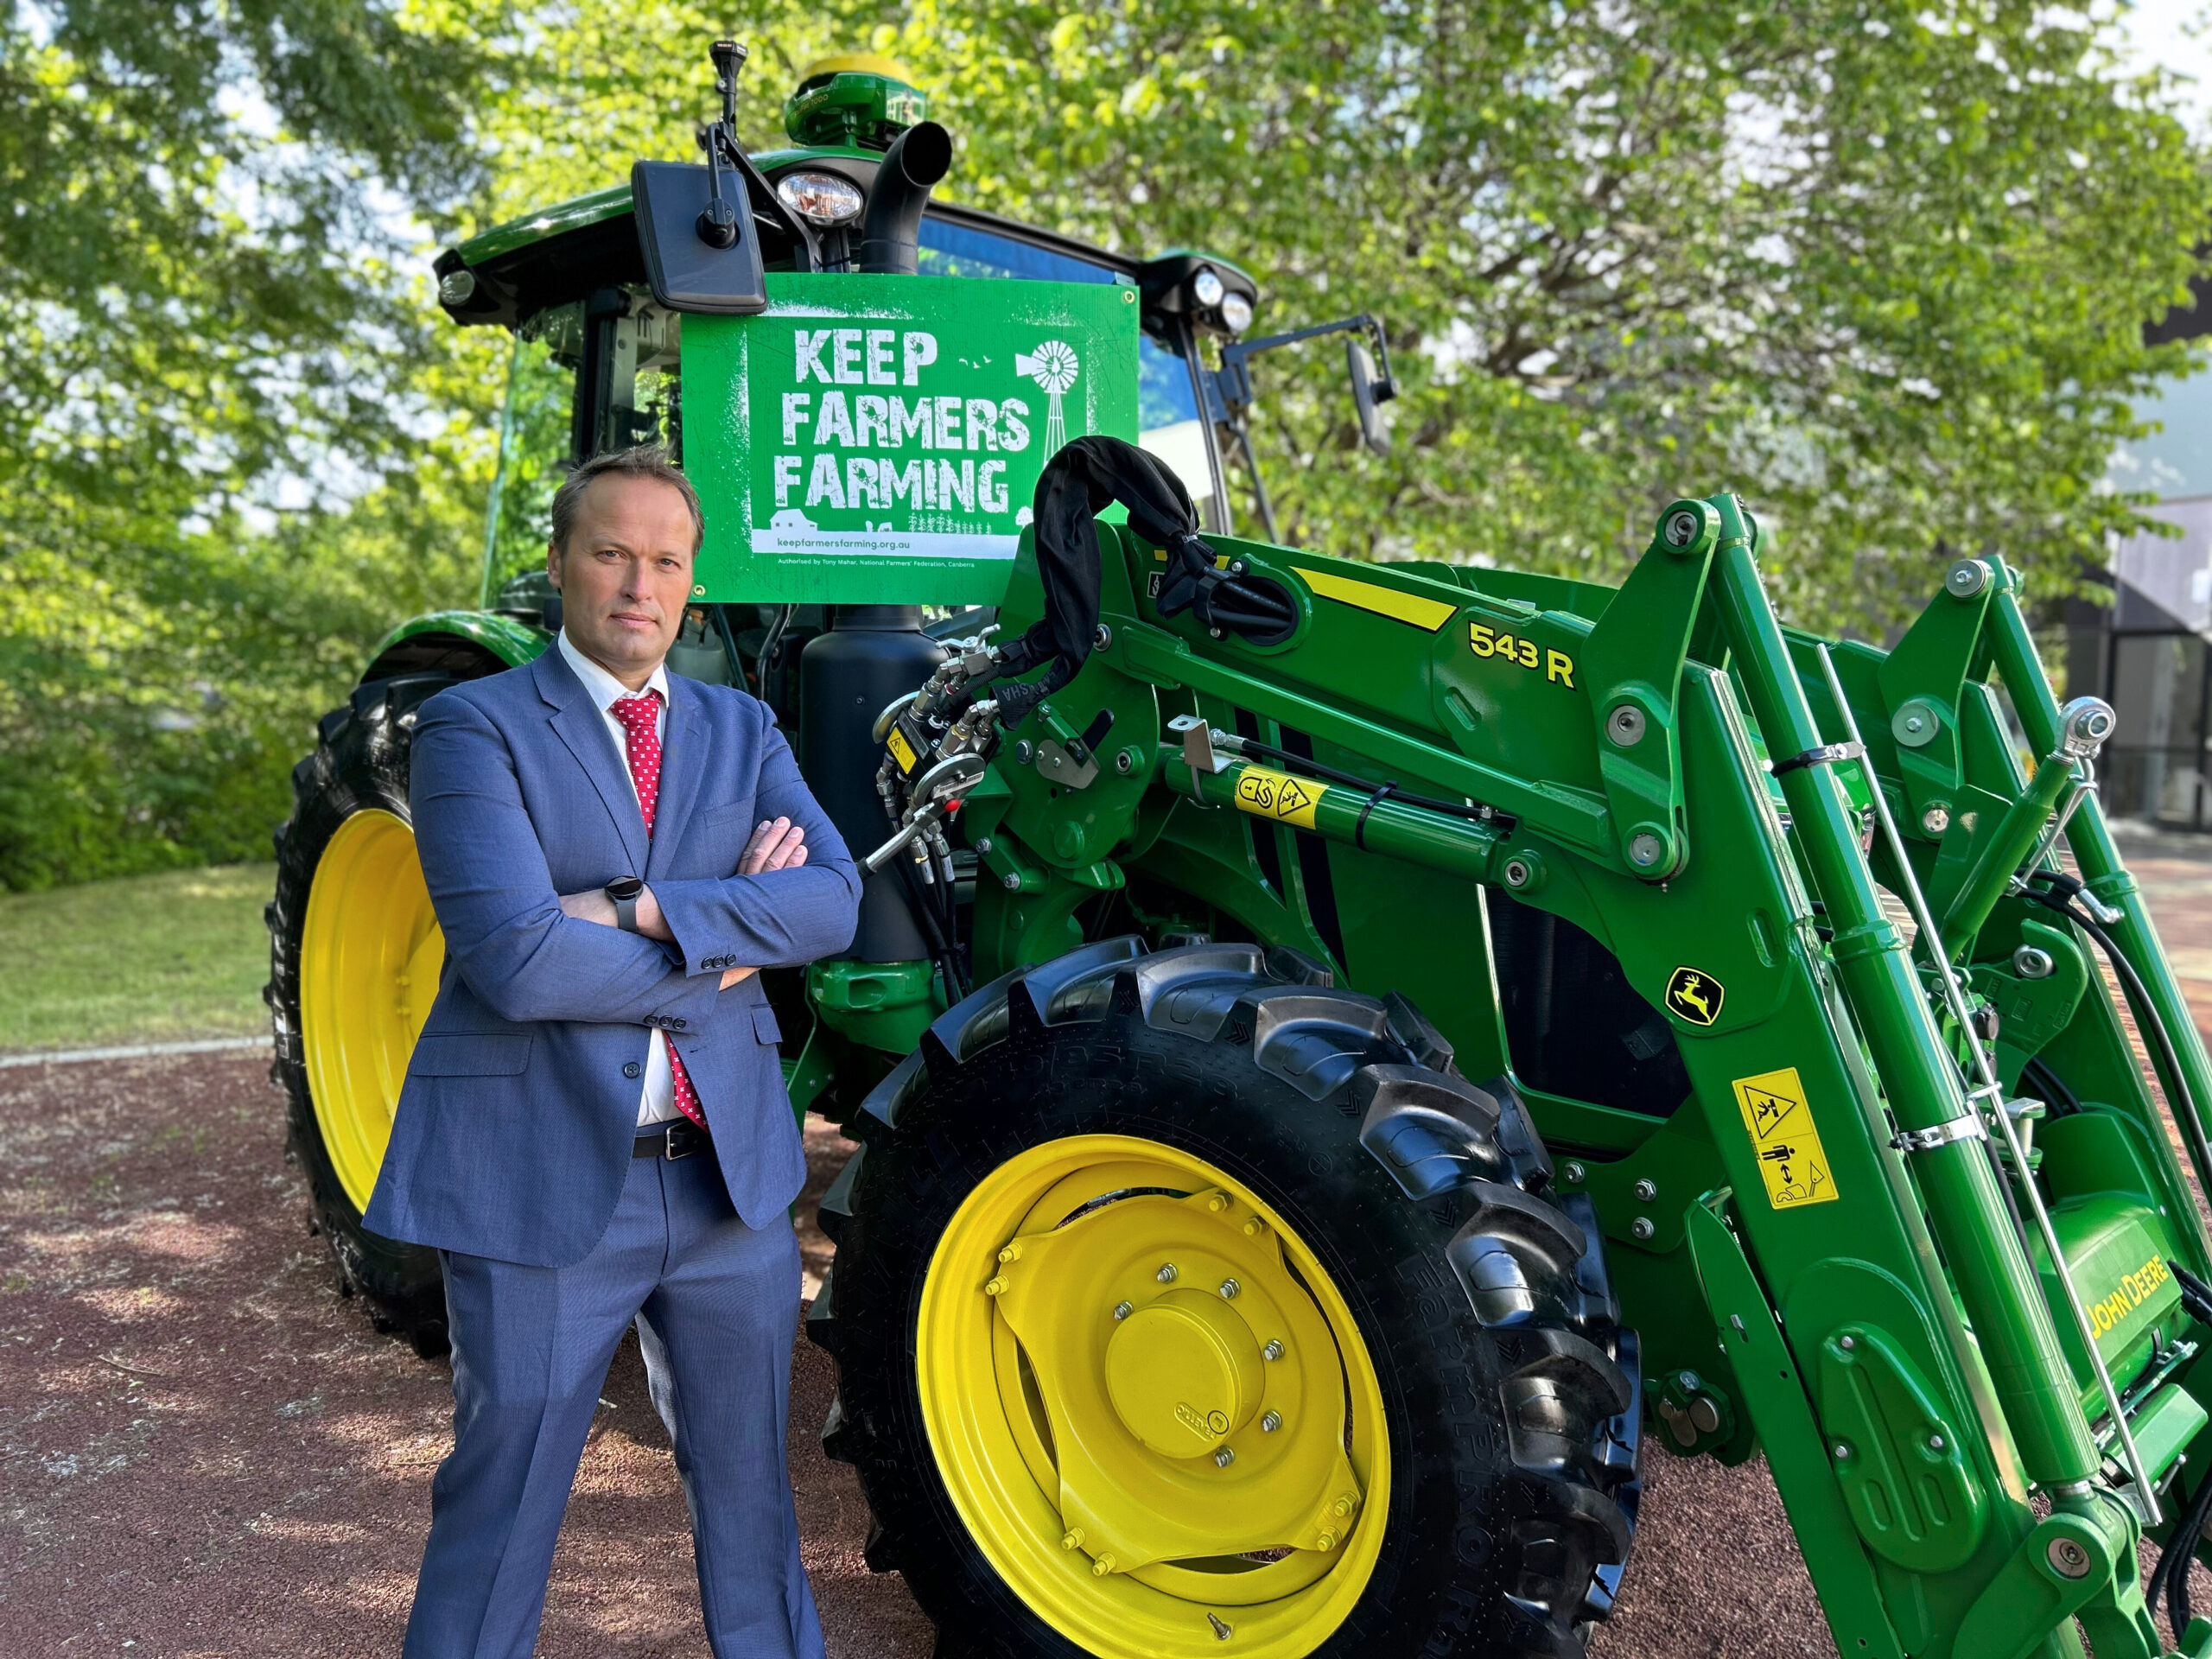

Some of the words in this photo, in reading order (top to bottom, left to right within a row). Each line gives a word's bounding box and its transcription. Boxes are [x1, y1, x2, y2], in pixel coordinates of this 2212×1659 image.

[794, 329, 938, 386] KEEP
[782, 390, 1030, 452] FARMERS
[774, 453, 1008, 513] FARMING
[777, 537, 911, 550] keepfarmersfarming.org.au
[1469, 621, 1540, 671] 543
[1547, 647, 1577, 691] R
[2085, 1287, 2133, 1340] JOHN
[2120, 1255, 2169, 1307] DEERE
